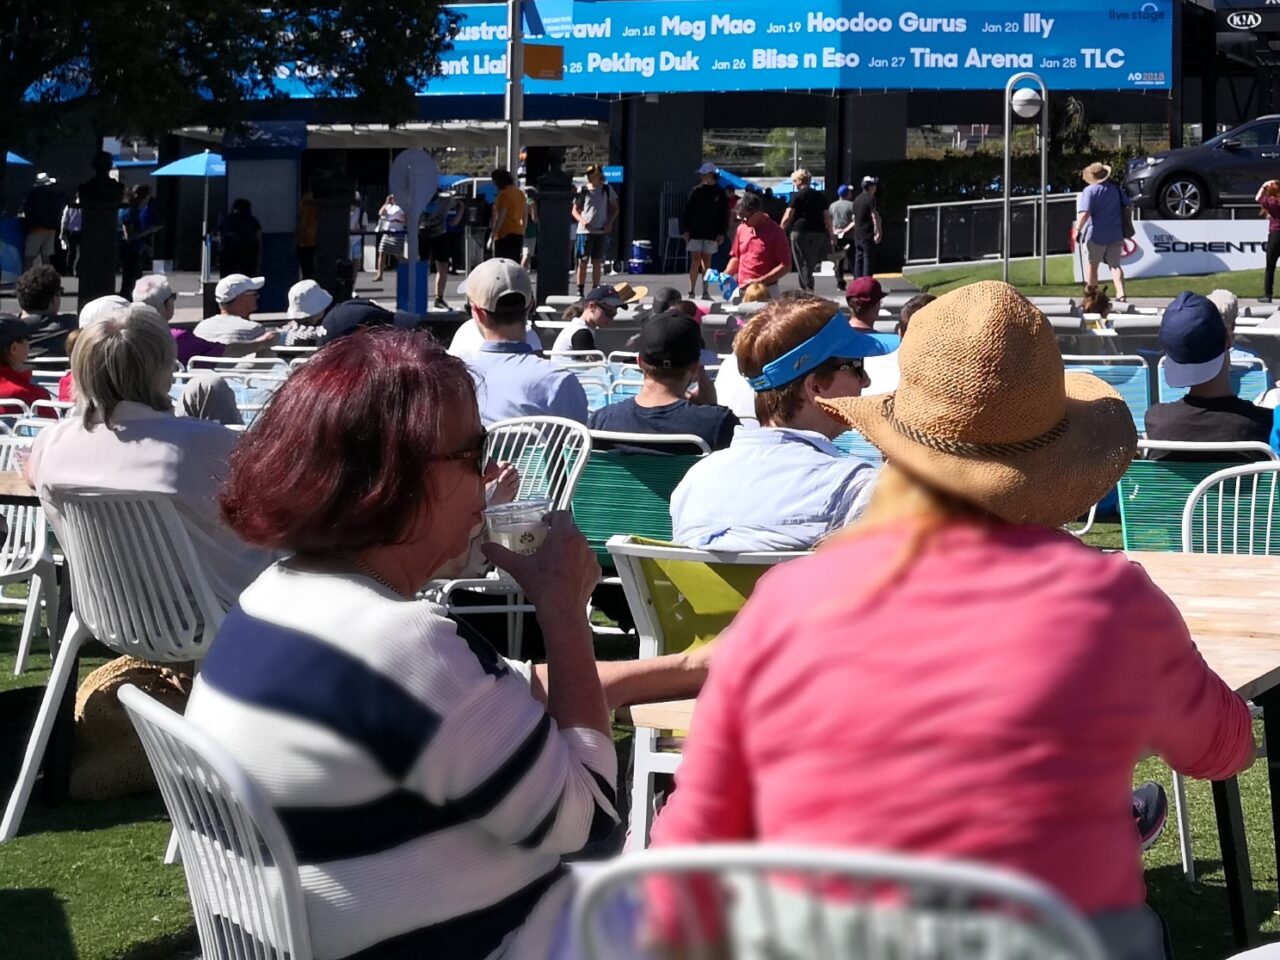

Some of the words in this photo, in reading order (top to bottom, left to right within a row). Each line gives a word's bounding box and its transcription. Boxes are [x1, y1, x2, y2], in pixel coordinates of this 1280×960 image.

[621, 26, 640, 37] Jan
[642, 25, 656, 36] 18
[661, 15, 706, 41] Meg
[710, 14, 756, 35] Mac
[766, 23, 785, 34] Jan
[788, 22, 802, 33] 19
[807, 11, 893, 33] Hoodoo
[898, 12, 967, 33] Gurus
[981, 22, 1002, 33] Jan
[1004, 22, 1019, 33] 20
[569, 62, 583, 73] 25
[587, 51, 656, 78] Peking
[659, 50, 700, 72] Duk
[712, 60, 731, 70] Jan
[732, 59, 746, 70] 26
[752, 49, 798, 70] Bliss
[803, 52, 817, 69] n
[822, 47, 860, 69] Eso
[868, 58, 888, 68] Jan
[891, 57, 905, 68] 27
[909, 47, 959, 69] Tina
[964, 48, 1034, 68] Arena
[1039, 58, 1060, 69] Jan
[1062, 58, 1077, 69] 28
[1080, 48, 1125, 69] TLC
